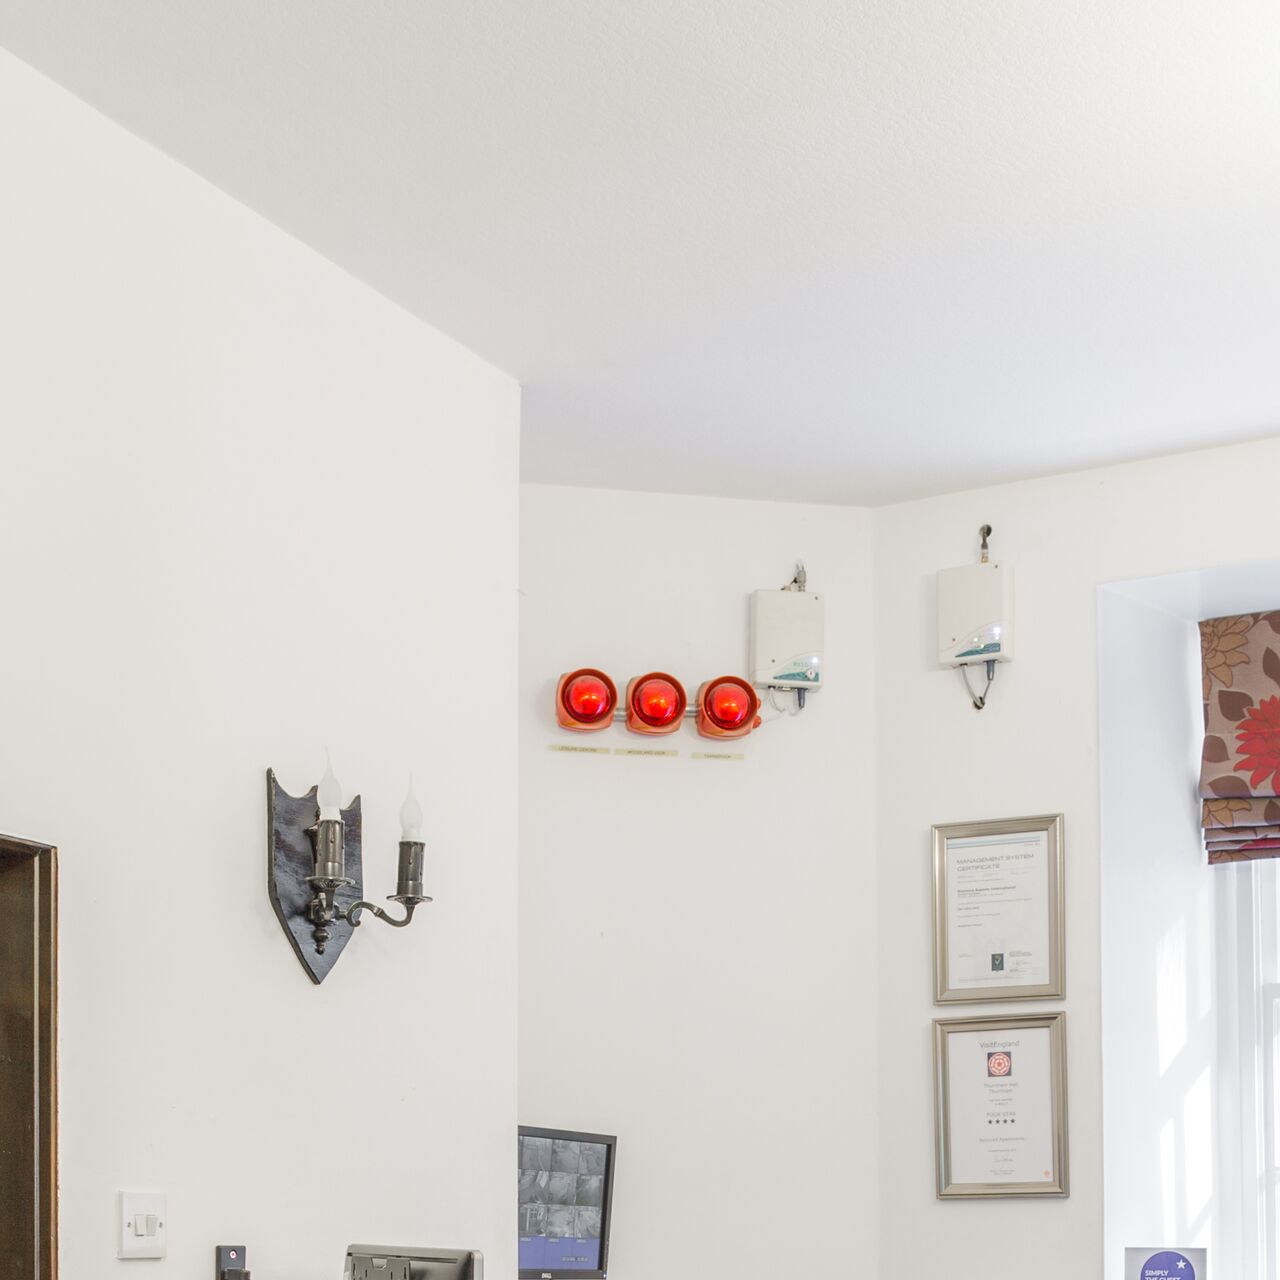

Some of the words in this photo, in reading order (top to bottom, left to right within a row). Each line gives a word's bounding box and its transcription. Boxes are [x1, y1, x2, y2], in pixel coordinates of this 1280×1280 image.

[957, 856, 1004, 865] MANAGEMENT
[957, 864, 1001, 872] CERTIFICATE
[979, 1040, 1020, 1049] VisitEngland
